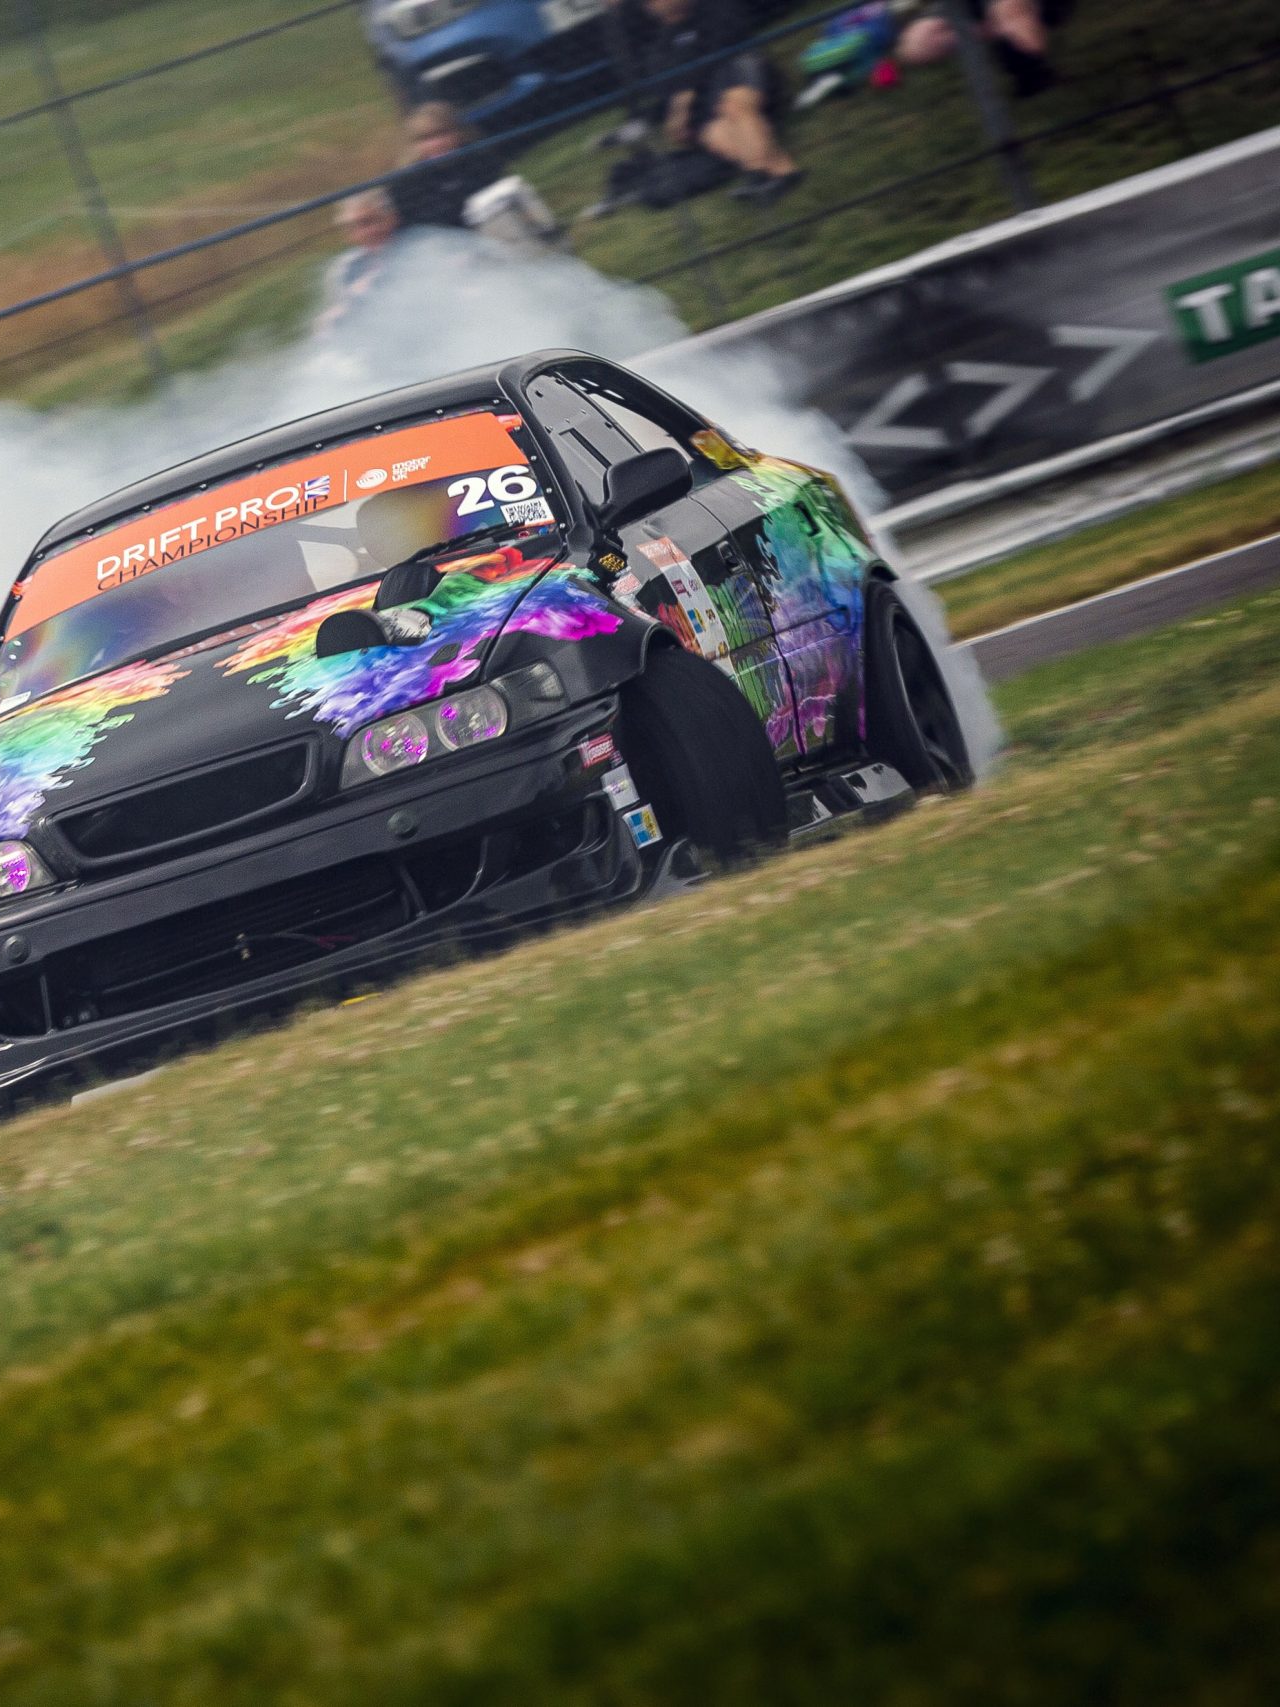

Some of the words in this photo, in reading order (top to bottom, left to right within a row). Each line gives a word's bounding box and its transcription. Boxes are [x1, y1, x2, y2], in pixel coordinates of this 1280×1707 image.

[392, 456, 431, 471] motor
[392, 463, 426, 477] sport
[392, 473, 408, 482] UK
[447, 465, 537, 517] 26
[96, 517, 207, 580] DRIFT
[215, 486, 300, 531] PRO
[97, 495, 328, 591] CHAMPIONSHIP
